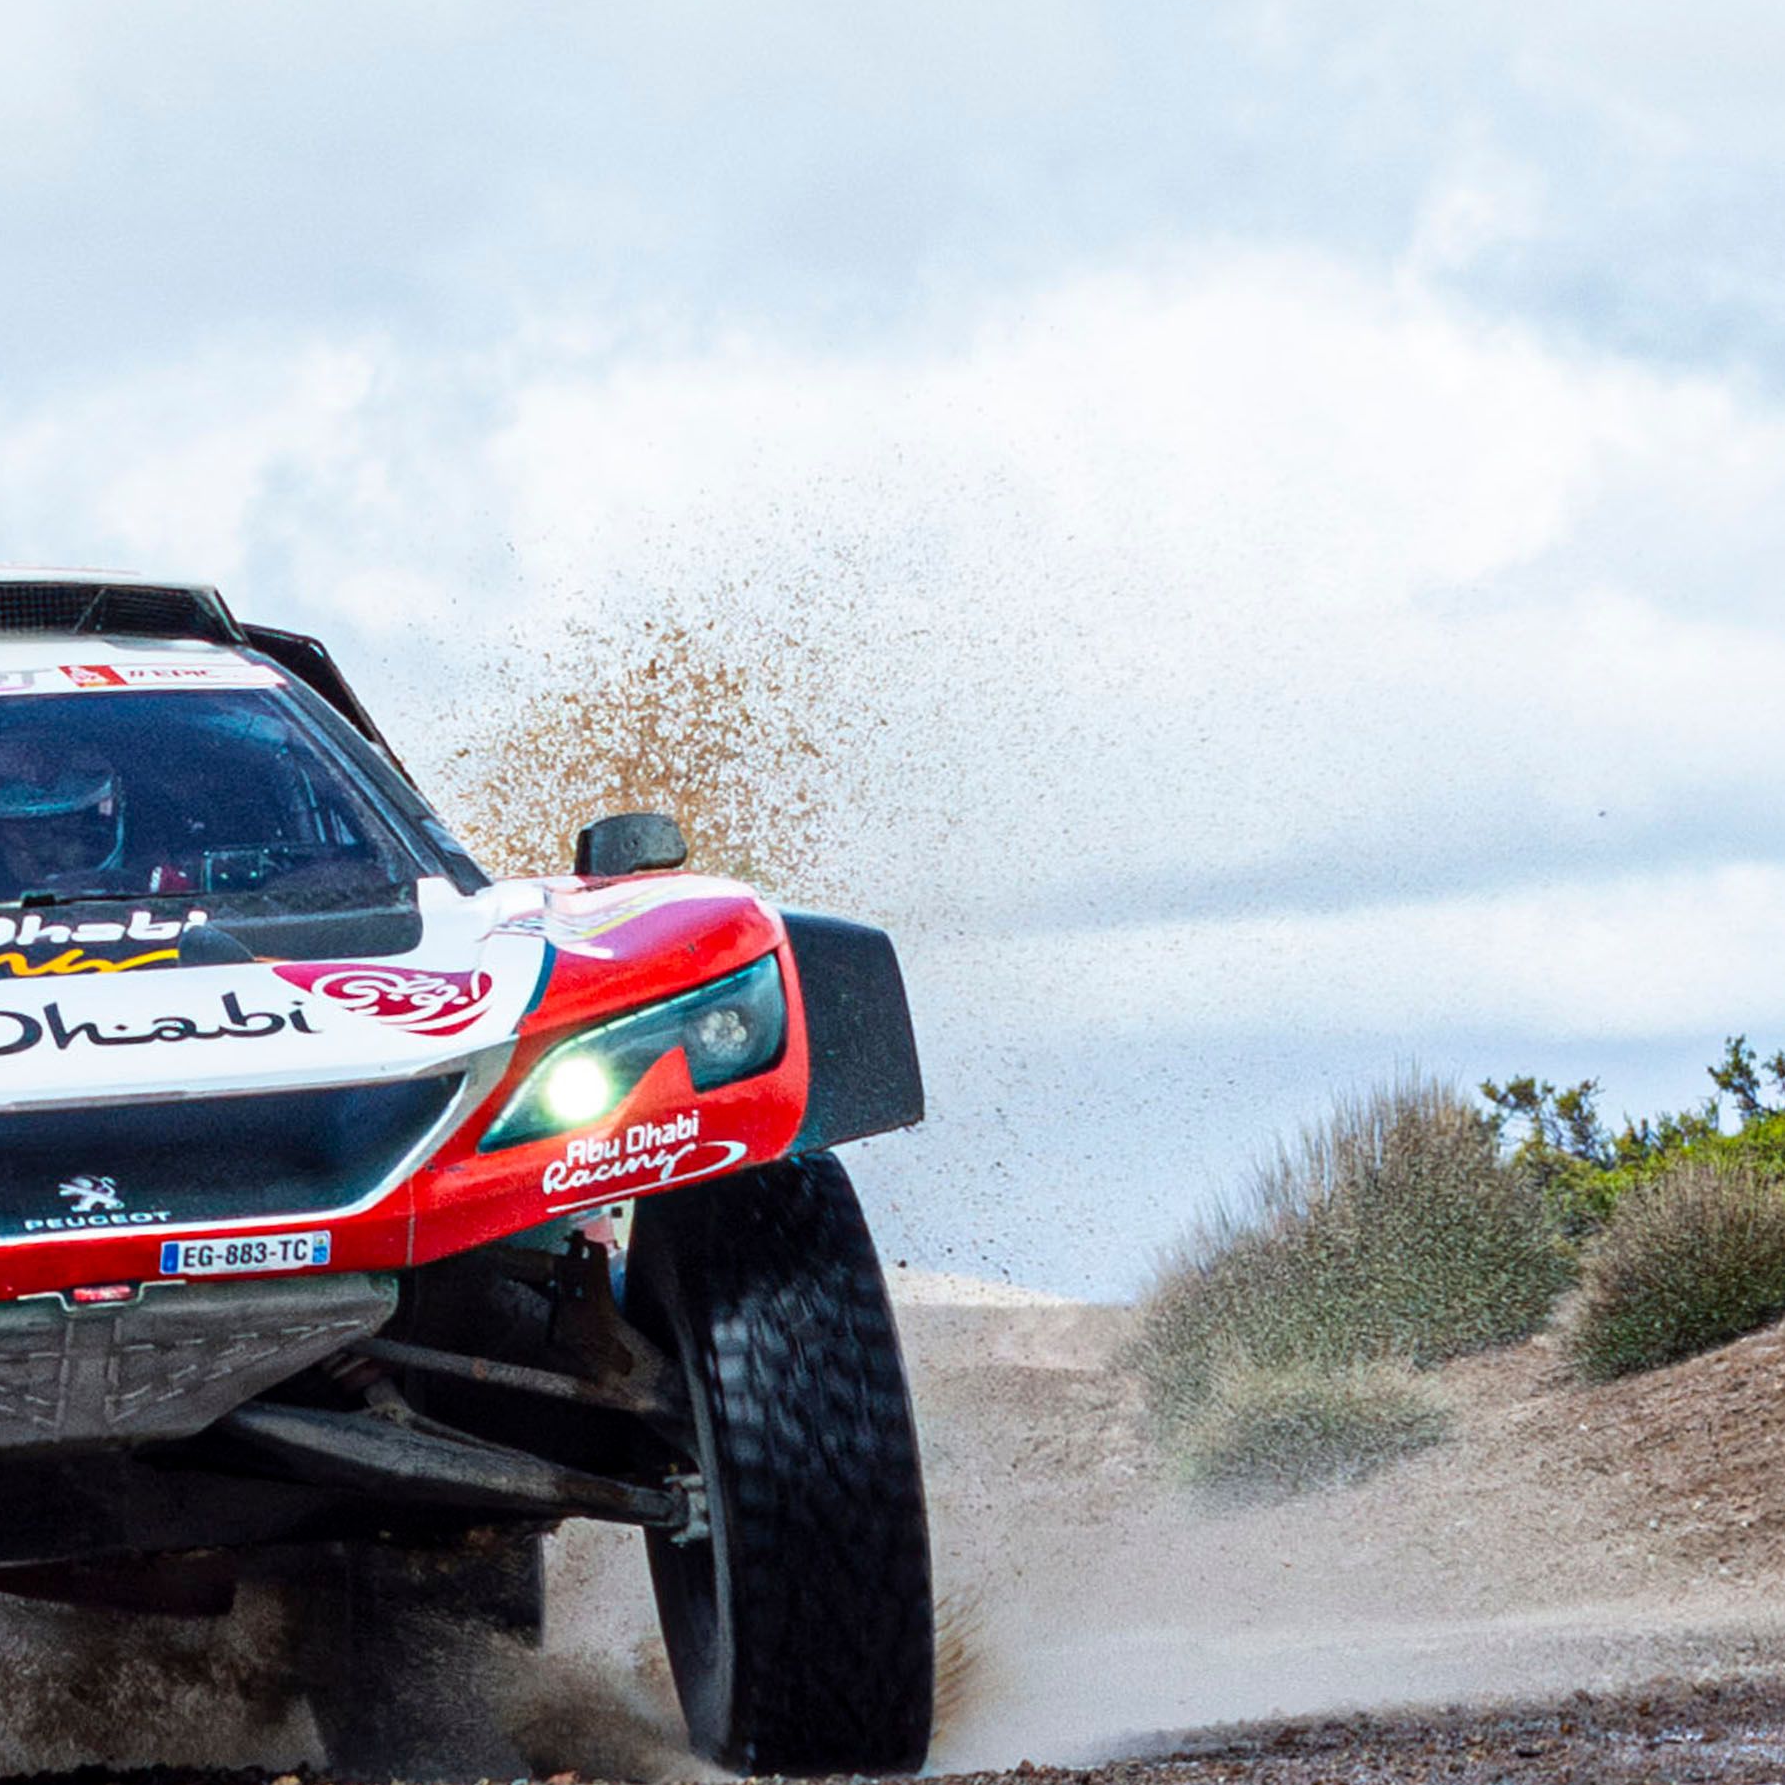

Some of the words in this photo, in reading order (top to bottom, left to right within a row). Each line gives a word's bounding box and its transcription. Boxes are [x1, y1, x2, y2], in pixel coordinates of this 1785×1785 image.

[566, 1138, 621, 1167] Abu
[625, 1109, 700, 1154] Dhabi
[542, 1142, 697, 1195] Racing
[24, 1211, 171, 1231] PEUGEOT
[182, 1239, 309, 1268] EG-883-TC
